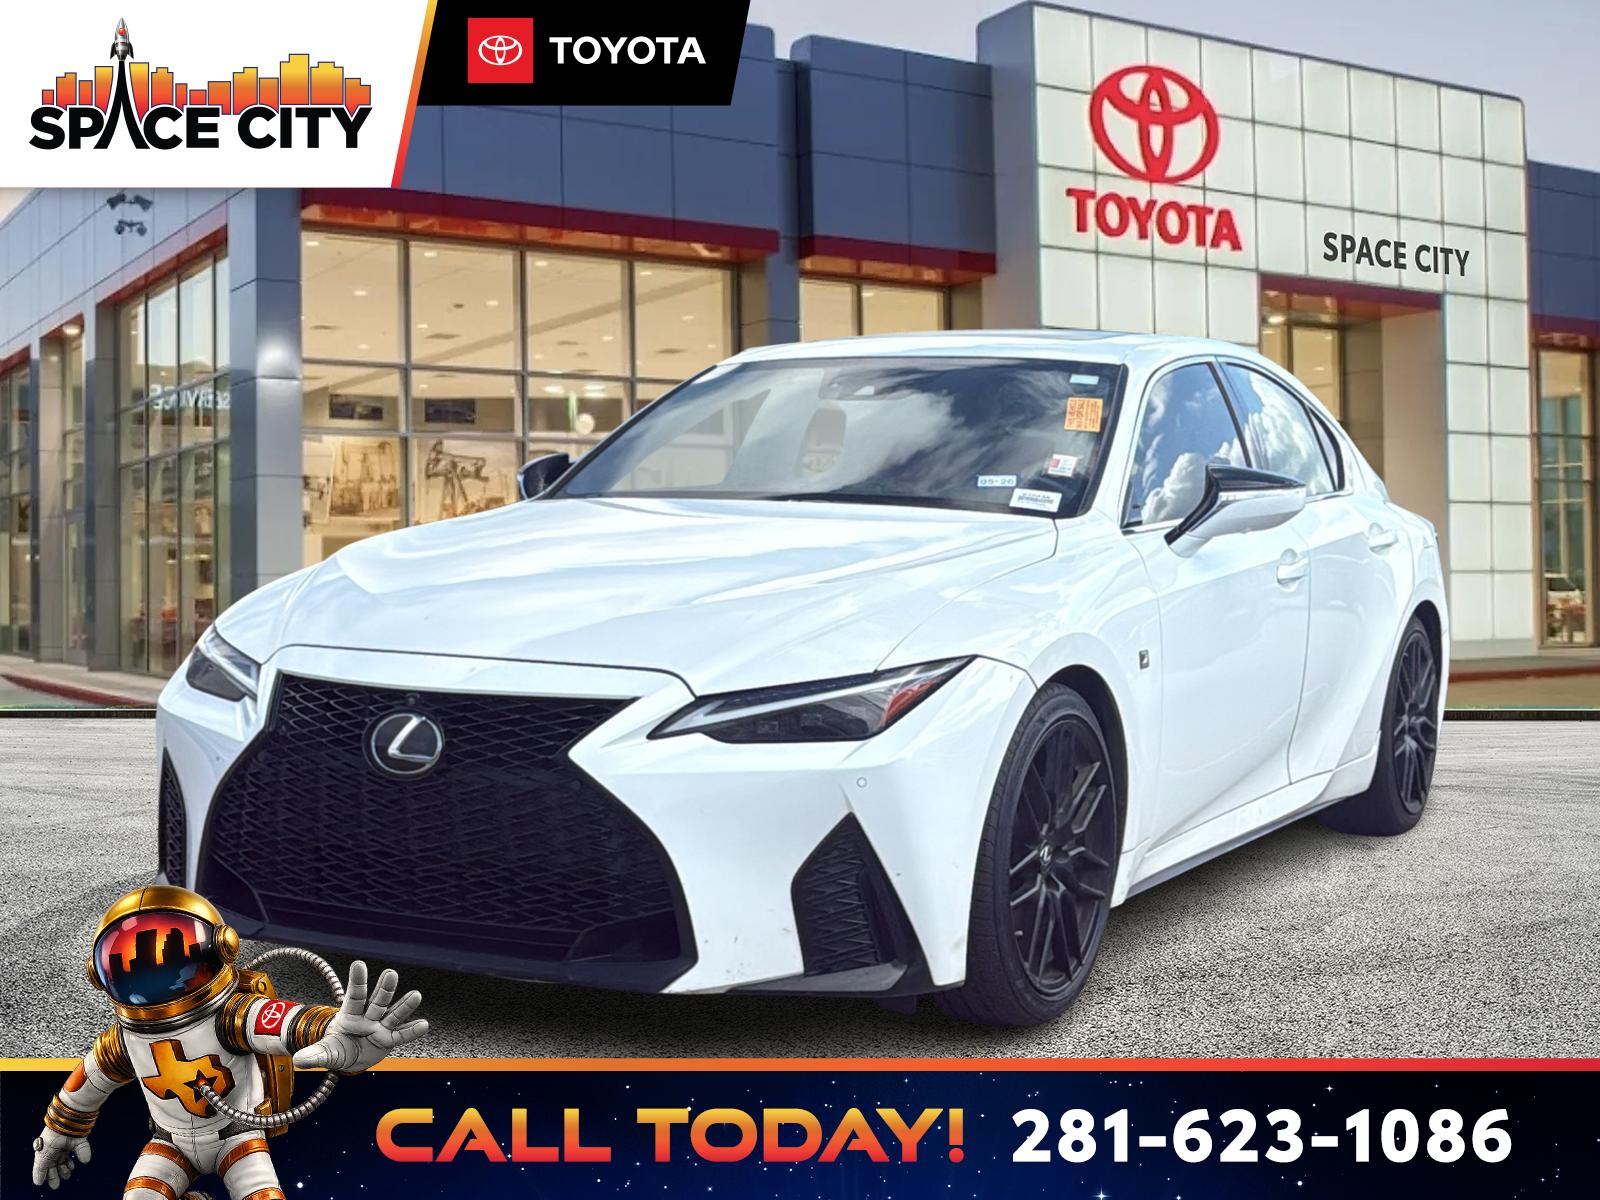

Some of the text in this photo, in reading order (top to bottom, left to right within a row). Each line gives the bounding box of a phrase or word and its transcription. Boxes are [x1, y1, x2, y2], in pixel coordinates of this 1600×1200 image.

[1066, 187, 1242, 252] TOYOTA
[1322, 231, 1471, 278] SPACE CITY
